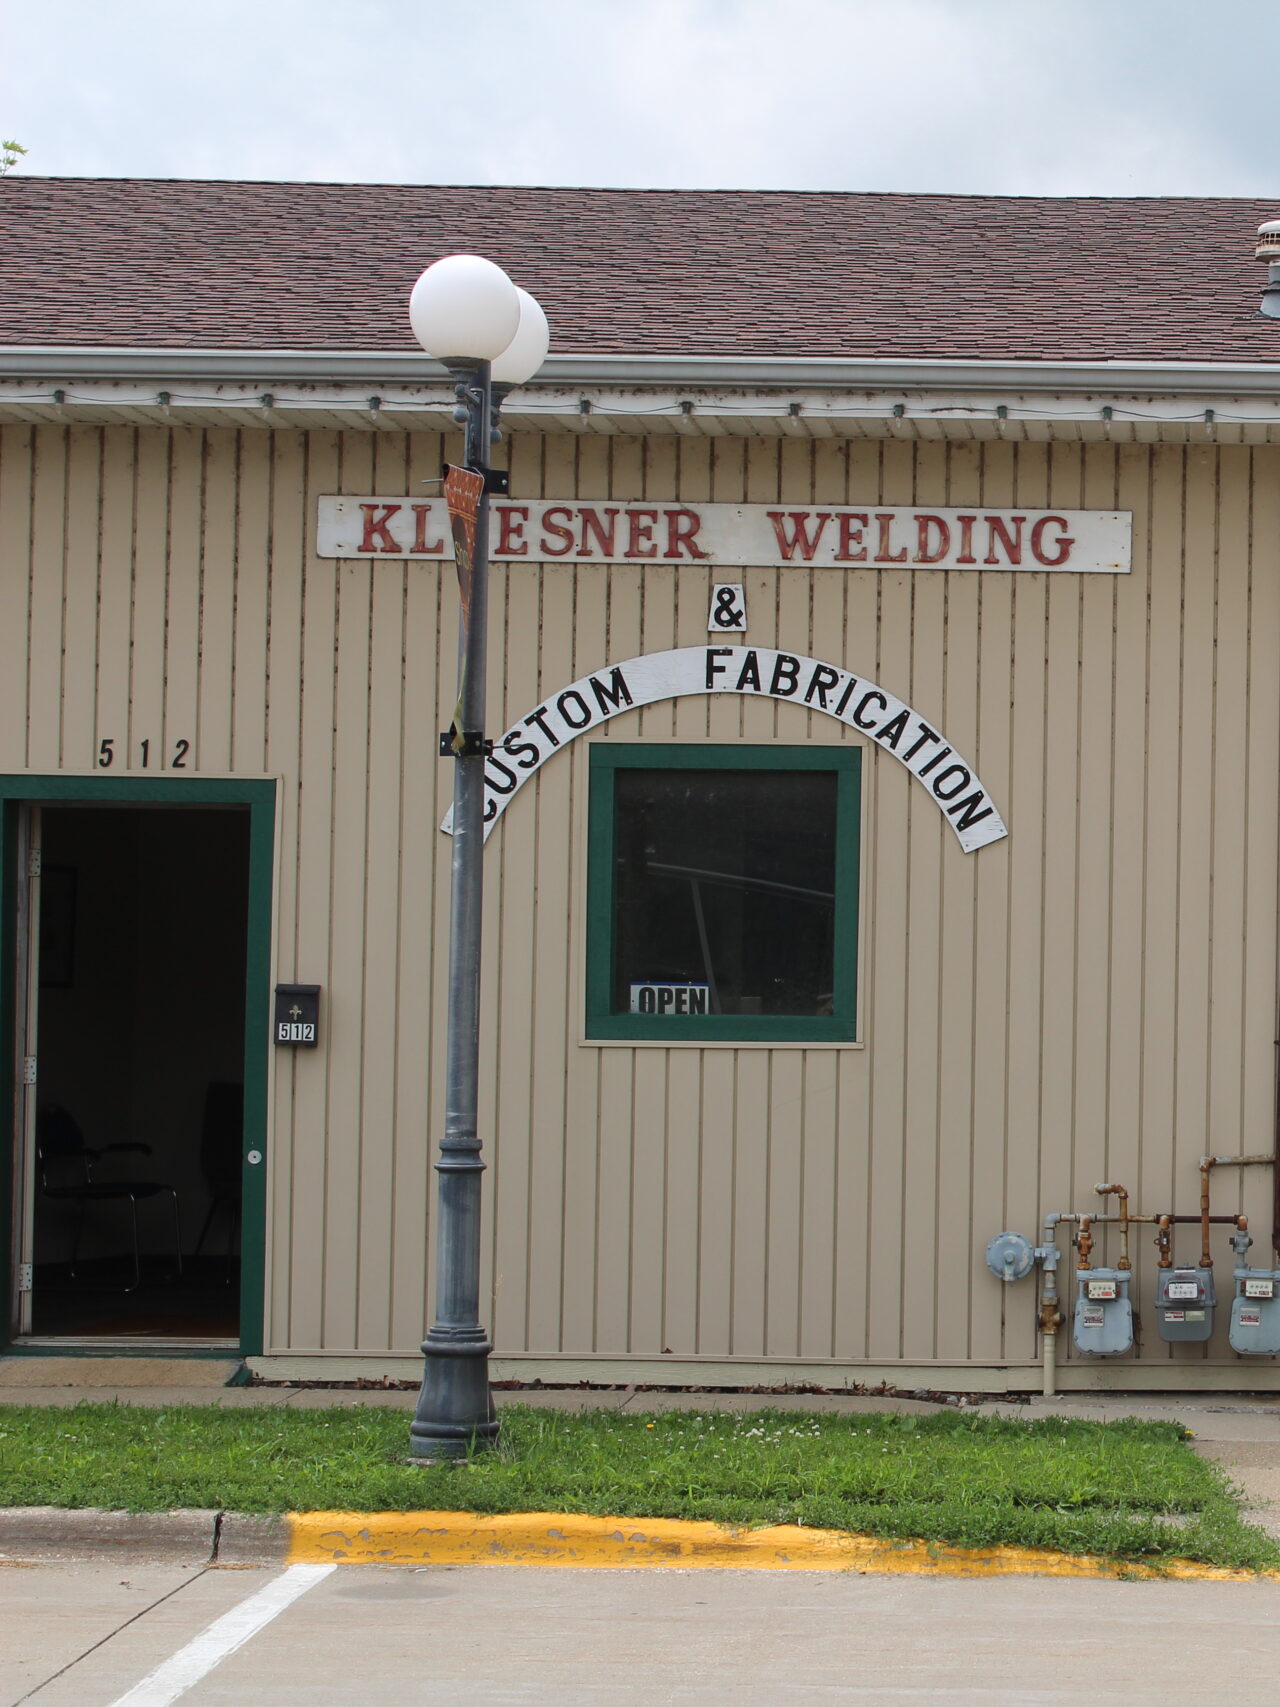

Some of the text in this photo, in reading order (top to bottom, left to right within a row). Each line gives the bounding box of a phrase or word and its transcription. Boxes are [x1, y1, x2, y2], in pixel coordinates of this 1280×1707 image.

[357, 504, 1076, 567] KLESNER WELDING
[713, 586, 744, 628] &
[99, 738, 190, 768] 512
[705, 648, 994, 834] FABRICATION
[638, 986, 706, 1015] OPEN
[279, 1023, 314, 1040] 512
